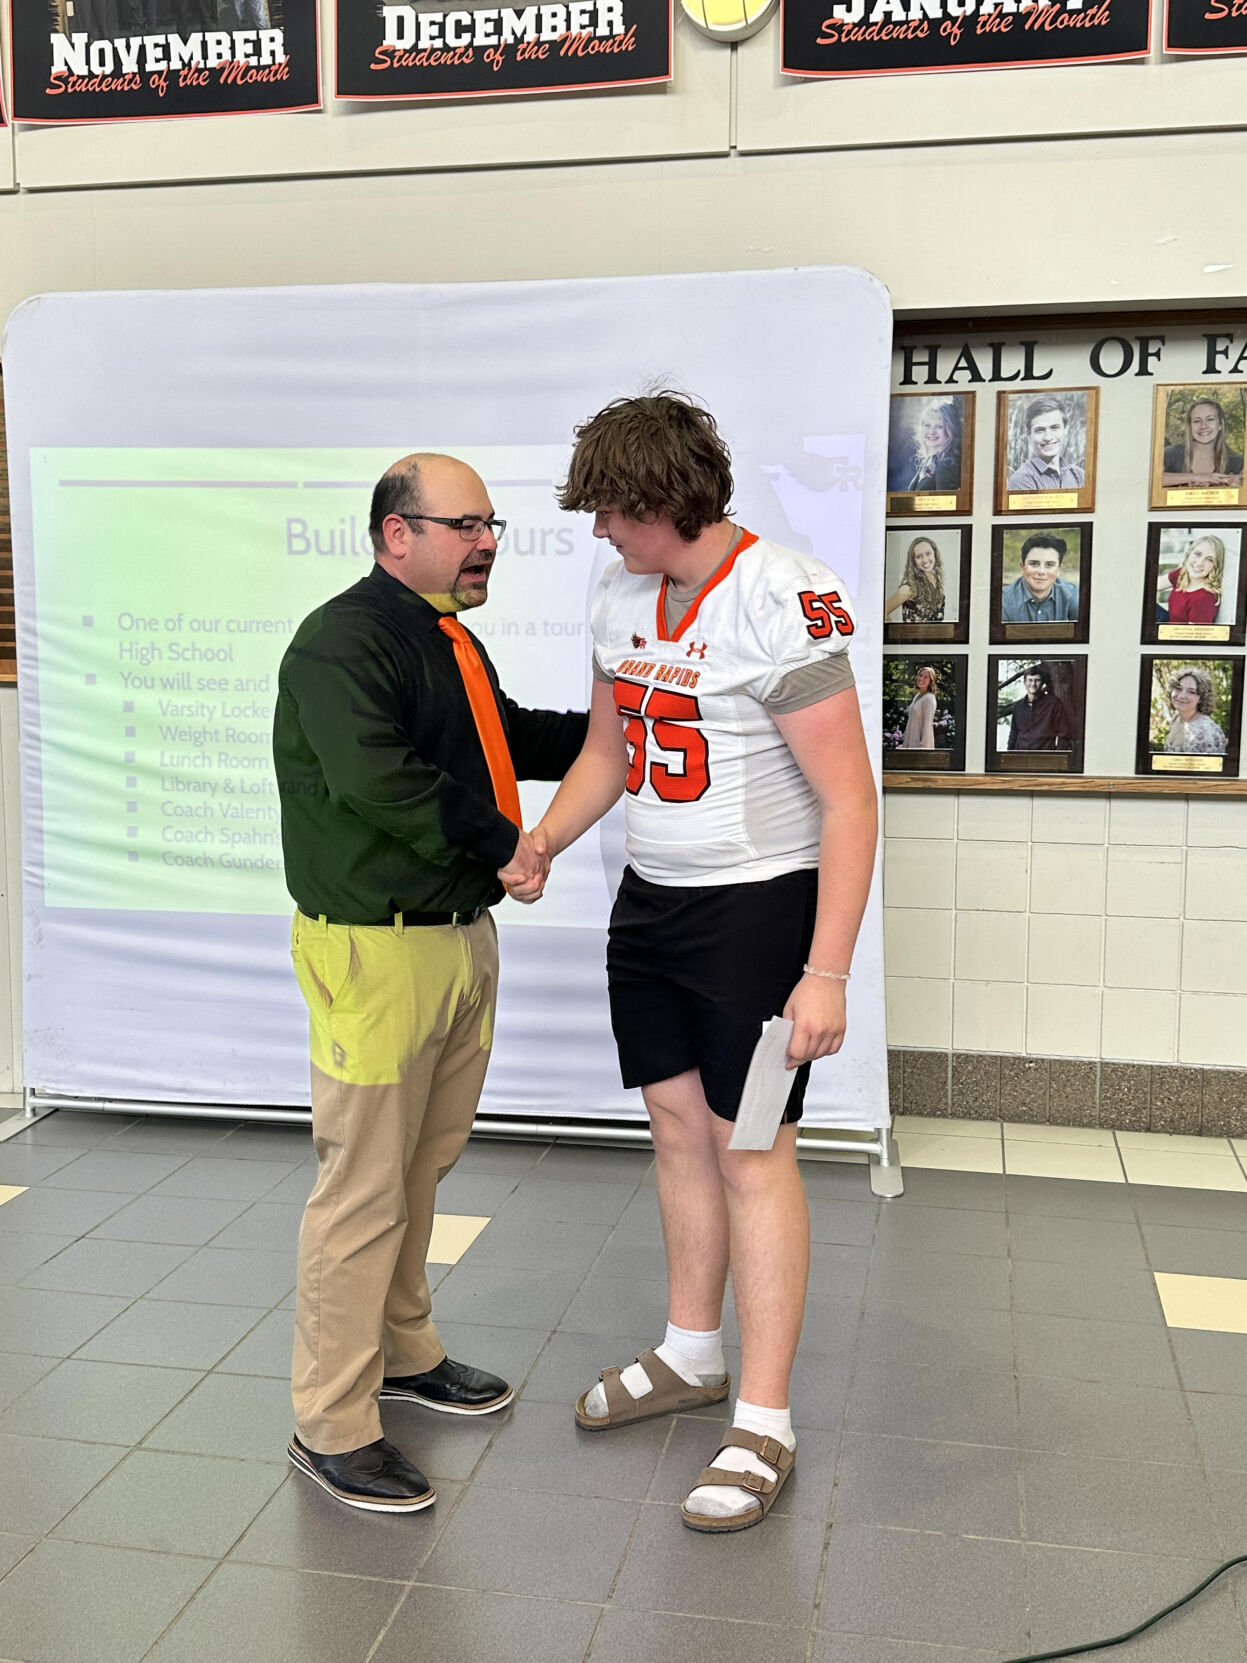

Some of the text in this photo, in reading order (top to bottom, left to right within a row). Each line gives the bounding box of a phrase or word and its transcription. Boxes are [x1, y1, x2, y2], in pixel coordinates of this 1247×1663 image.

[816, 0, 1112, 46] Students of the Month
[833, 0, 1085, 24] JANU
[382, 0, 625, 50] DECEMBER
[50, 28, 286, 76] NOVEMBER
[370, 24, 637, 72] Students of the Month
[45, 55, 290, 97] Students of the Month
[898, 340, 1054, 386] HALL
[1088, 334, 1166, 379] OF
[117, 612, 159, 632] One
[164, 612, 185, 633] of
[189, 617, 221, 633] our
[226, 617, 294, 634] current
[502, 617, 520, 636] in
[525, 621, 537, 636] a
[543, 618, 584, 637] tour
[797, 590, 855, 641] 55
[118, 641, 235, 666] High School
[120, 671, 270, 693] You will see and
[653, 663, 701, 689] RAPIDS
[158, 699, 217, 721] Varsity
[158, 725, 220, 747] Weight
[614, 677, 711, 803] 55
[159, 750, 269, 769] Lunch Room
[161, 776, 275, 798] Library & Loft
[161, 801, 214, 818] Coach
[161, 826, 214, 843] Coach
[161, 851, 214, 867] Coach
